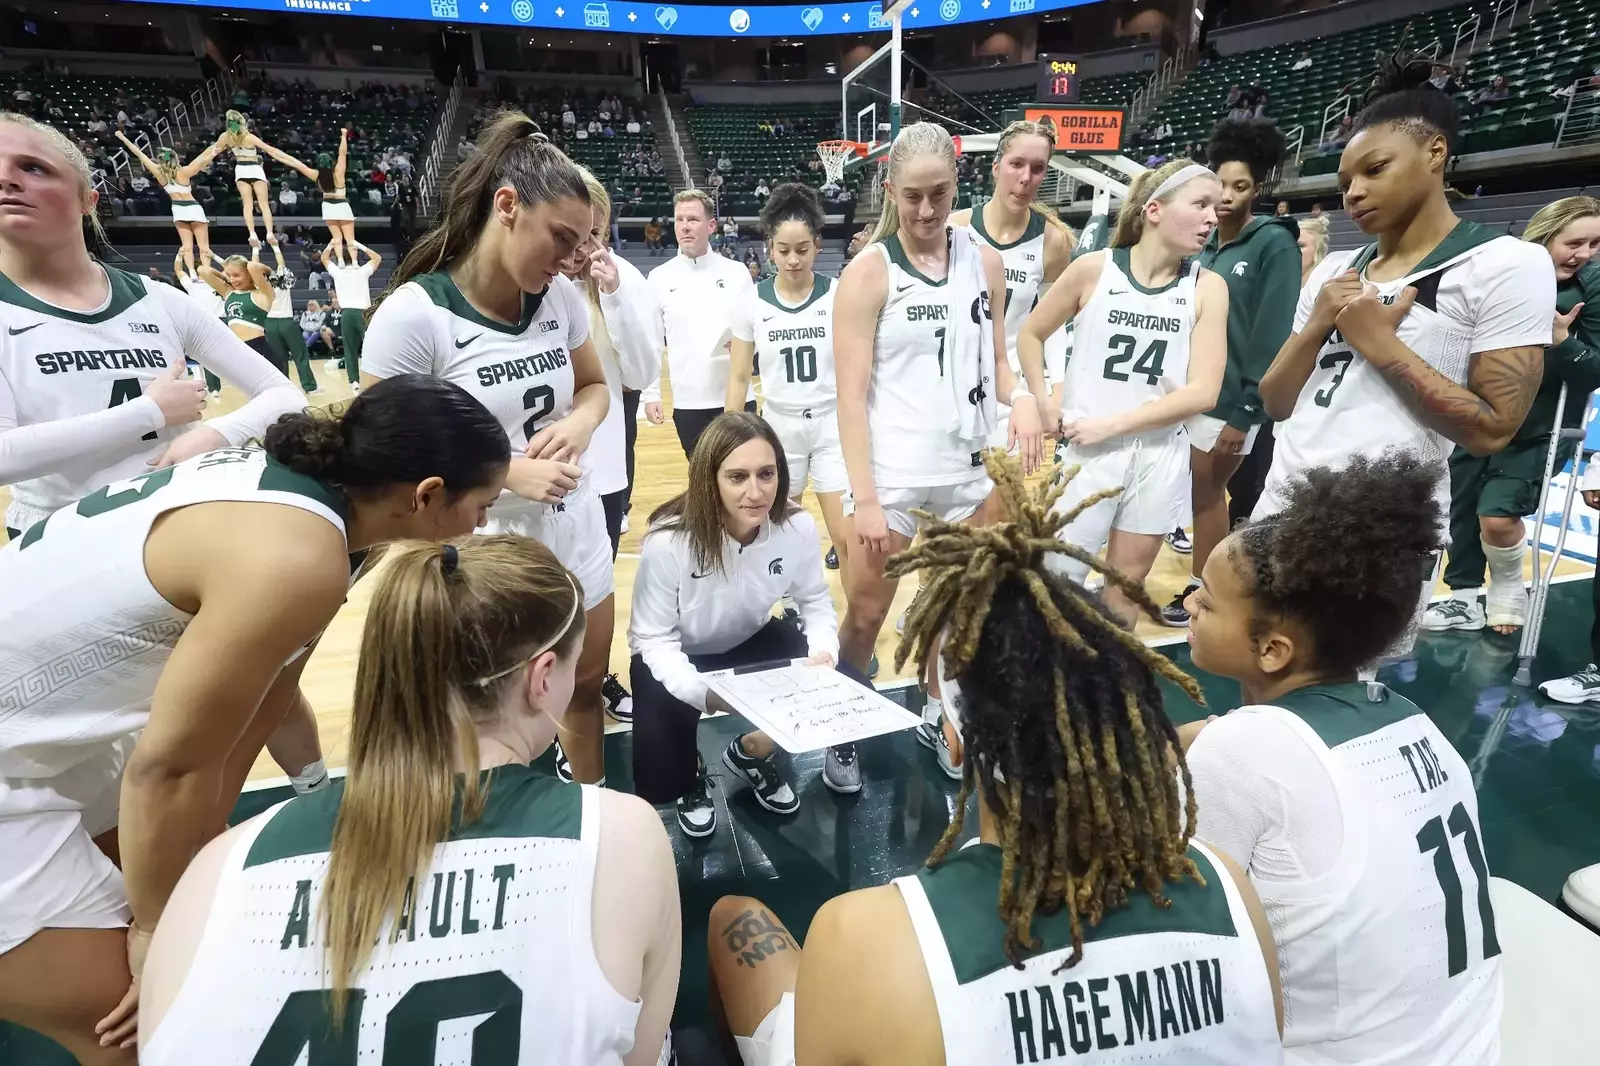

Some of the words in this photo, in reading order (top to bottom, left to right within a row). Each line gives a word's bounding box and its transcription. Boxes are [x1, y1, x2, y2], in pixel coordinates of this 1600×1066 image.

[285, 0, 352, 12] INSURANCE
[1051, 61, 1076, 74] 9:44
[1061, 116, 1119, 128] GORILLA
[1070, 132, 1105, 144] GLUE
[906, 304, 949, 322] SPAR
[1107, 309, 1181, 333] SPARTANS
[768, 326, 826, 342] SPARTANS
[35, 348, 168, 375] SPARTANS
[476, 347, 567, 388] SPARTANS
[779, 345, 818, 383] 10
[1102, 333, 1169, 386] 24
[1314, 350, 1355, 409] 3
[522, 384, 556, 444] 2
[1415, 801, 1502, 979] 11
[280, 863, 516, 950] AAULT
[1004, 957, 1225, 1065] HAGEMANN
